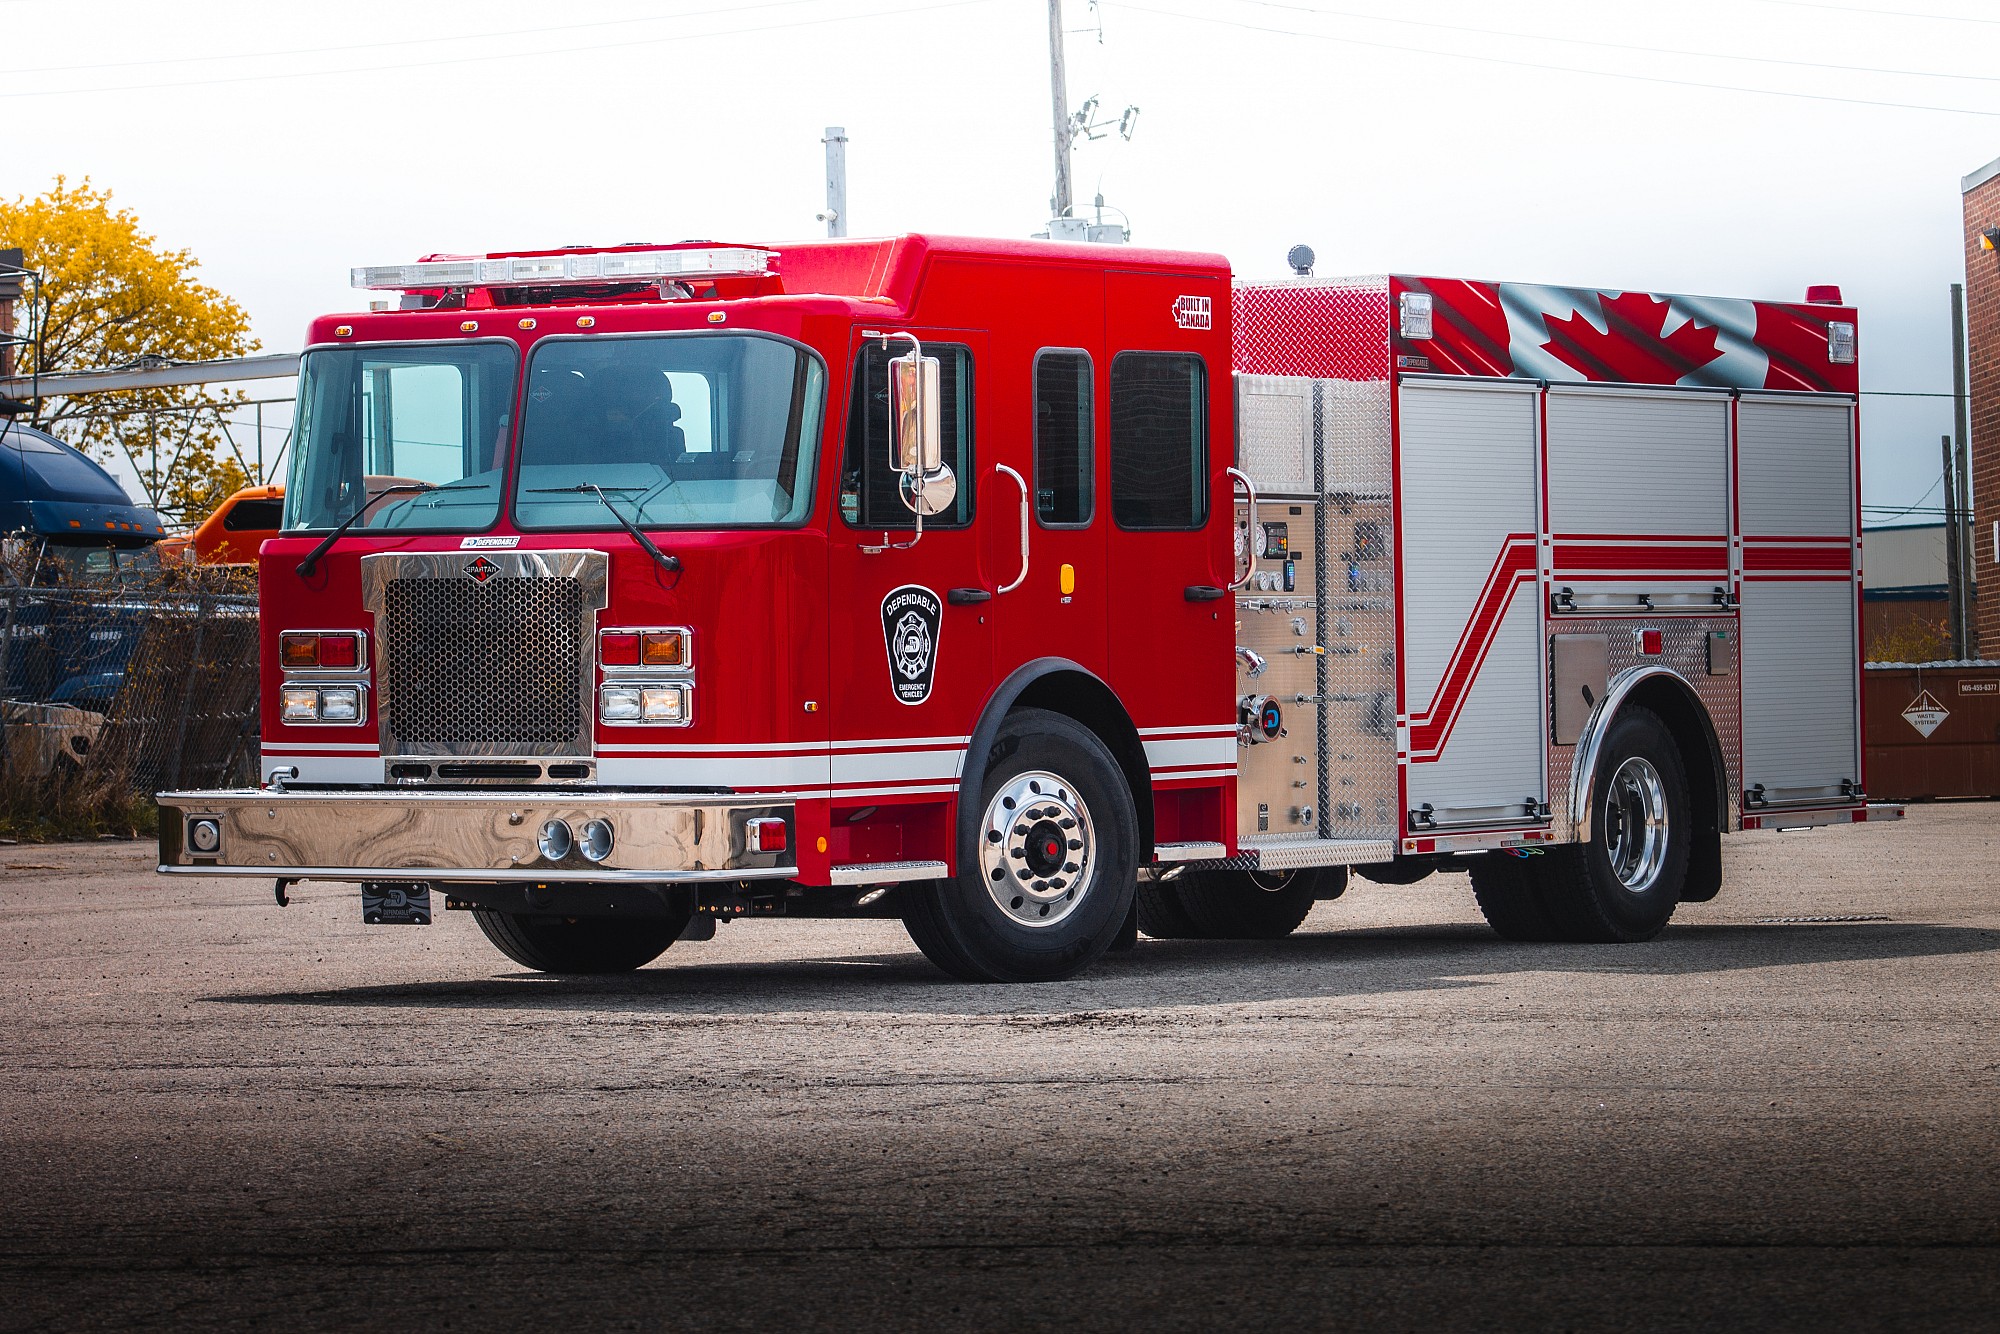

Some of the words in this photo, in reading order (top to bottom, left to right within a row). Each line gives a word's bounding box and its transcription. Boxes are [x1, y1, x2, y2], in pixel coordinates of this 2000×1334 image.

[1180, 297, 1200, 311] BUILT
[1201, 298, 1209, 312] IN
[1180, 313, 1210, 328] CANADA
[476, 538, 517, 546] DEPENDABLE
[886, 594, 937, 616] DEPENDABLE
